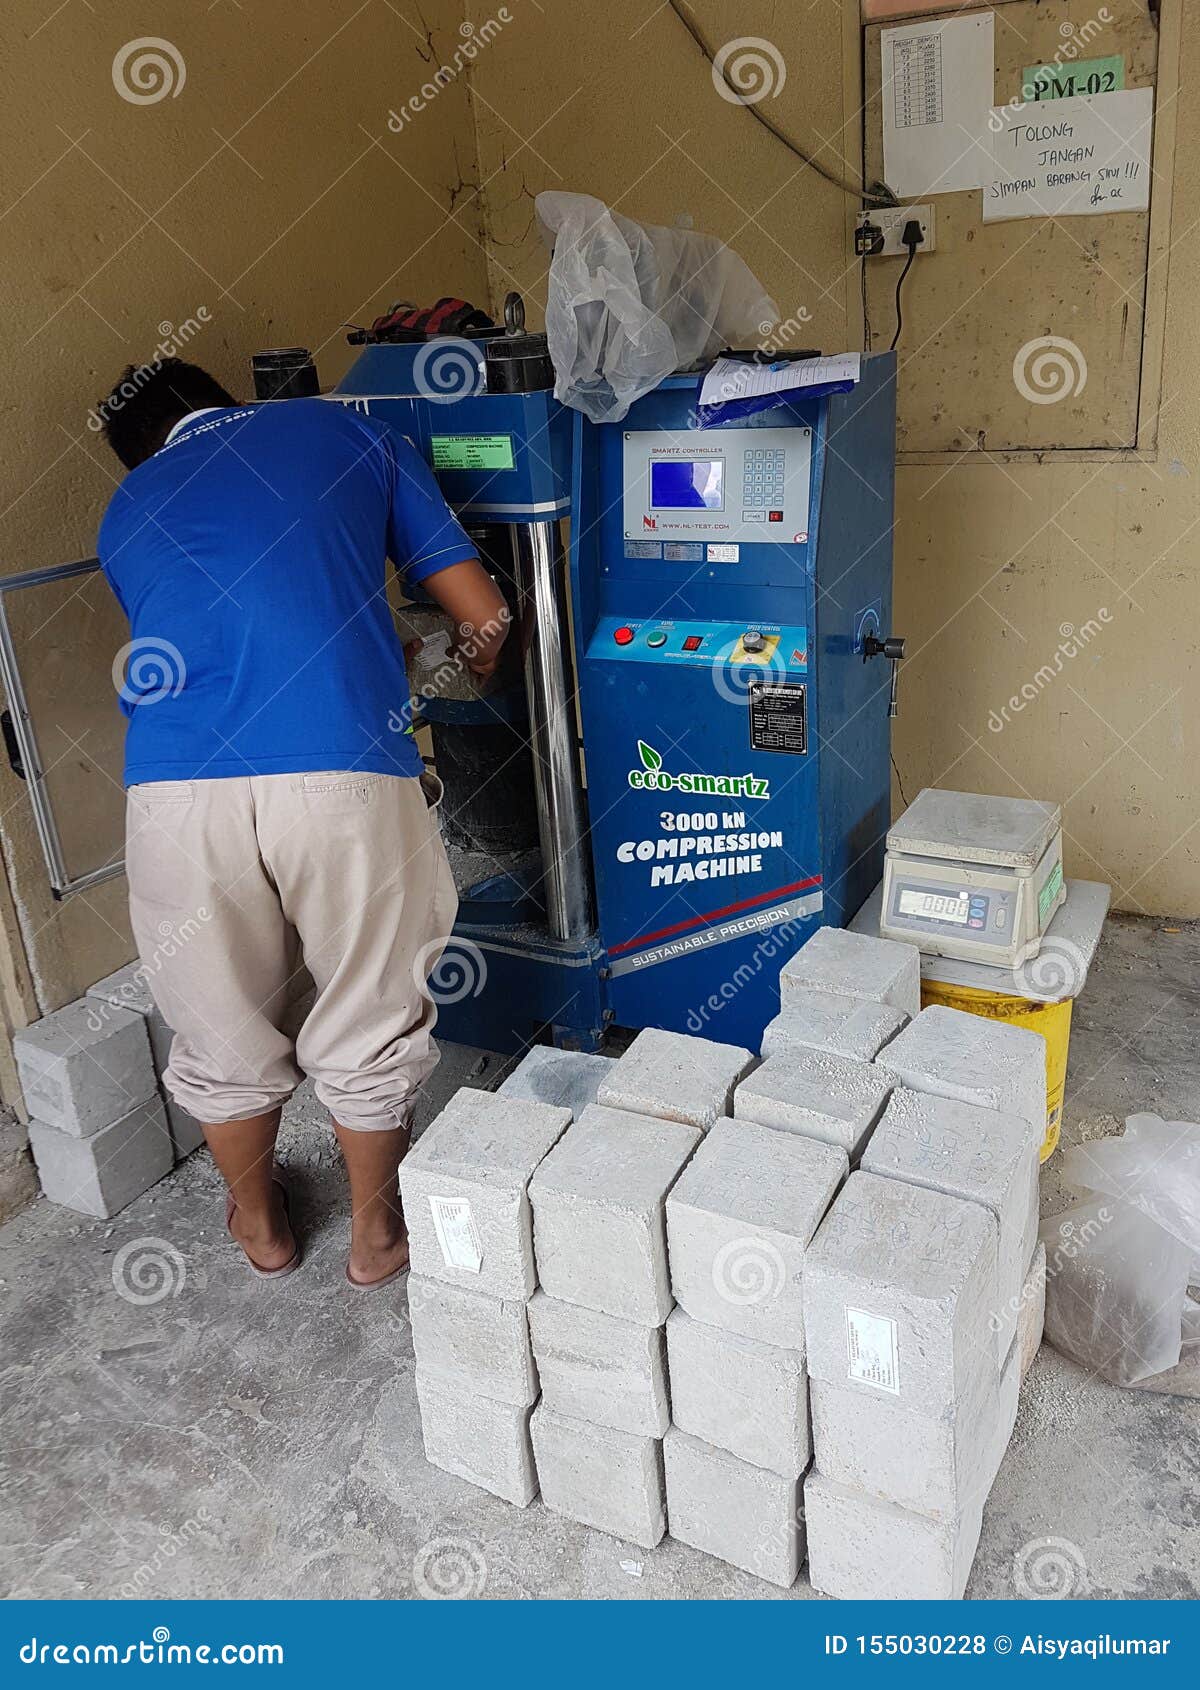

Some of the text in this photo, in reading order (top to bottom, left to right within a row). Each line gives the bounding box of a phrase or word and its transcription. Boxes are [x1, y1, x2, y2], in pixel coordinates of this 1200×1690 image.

[1033, 71, 1116, 102] PM-02
[1008, 122, 1073, 147] TOLONG
[1038, 145, 1095, 166] JANGAN
[990, 177, 1036, 199] SIMPAN
[1046, 172, 1091, 187] BARANG
[628, 768, 770, 800] eco-smartz
[659, 811, 746, 832] 3000 kN
[616, 831, 783, 863] COMPRESSION
[650, 854, 763, 888] MACHINE
[632, 907, 791, 968] SUSTAINABLE PRECISION
